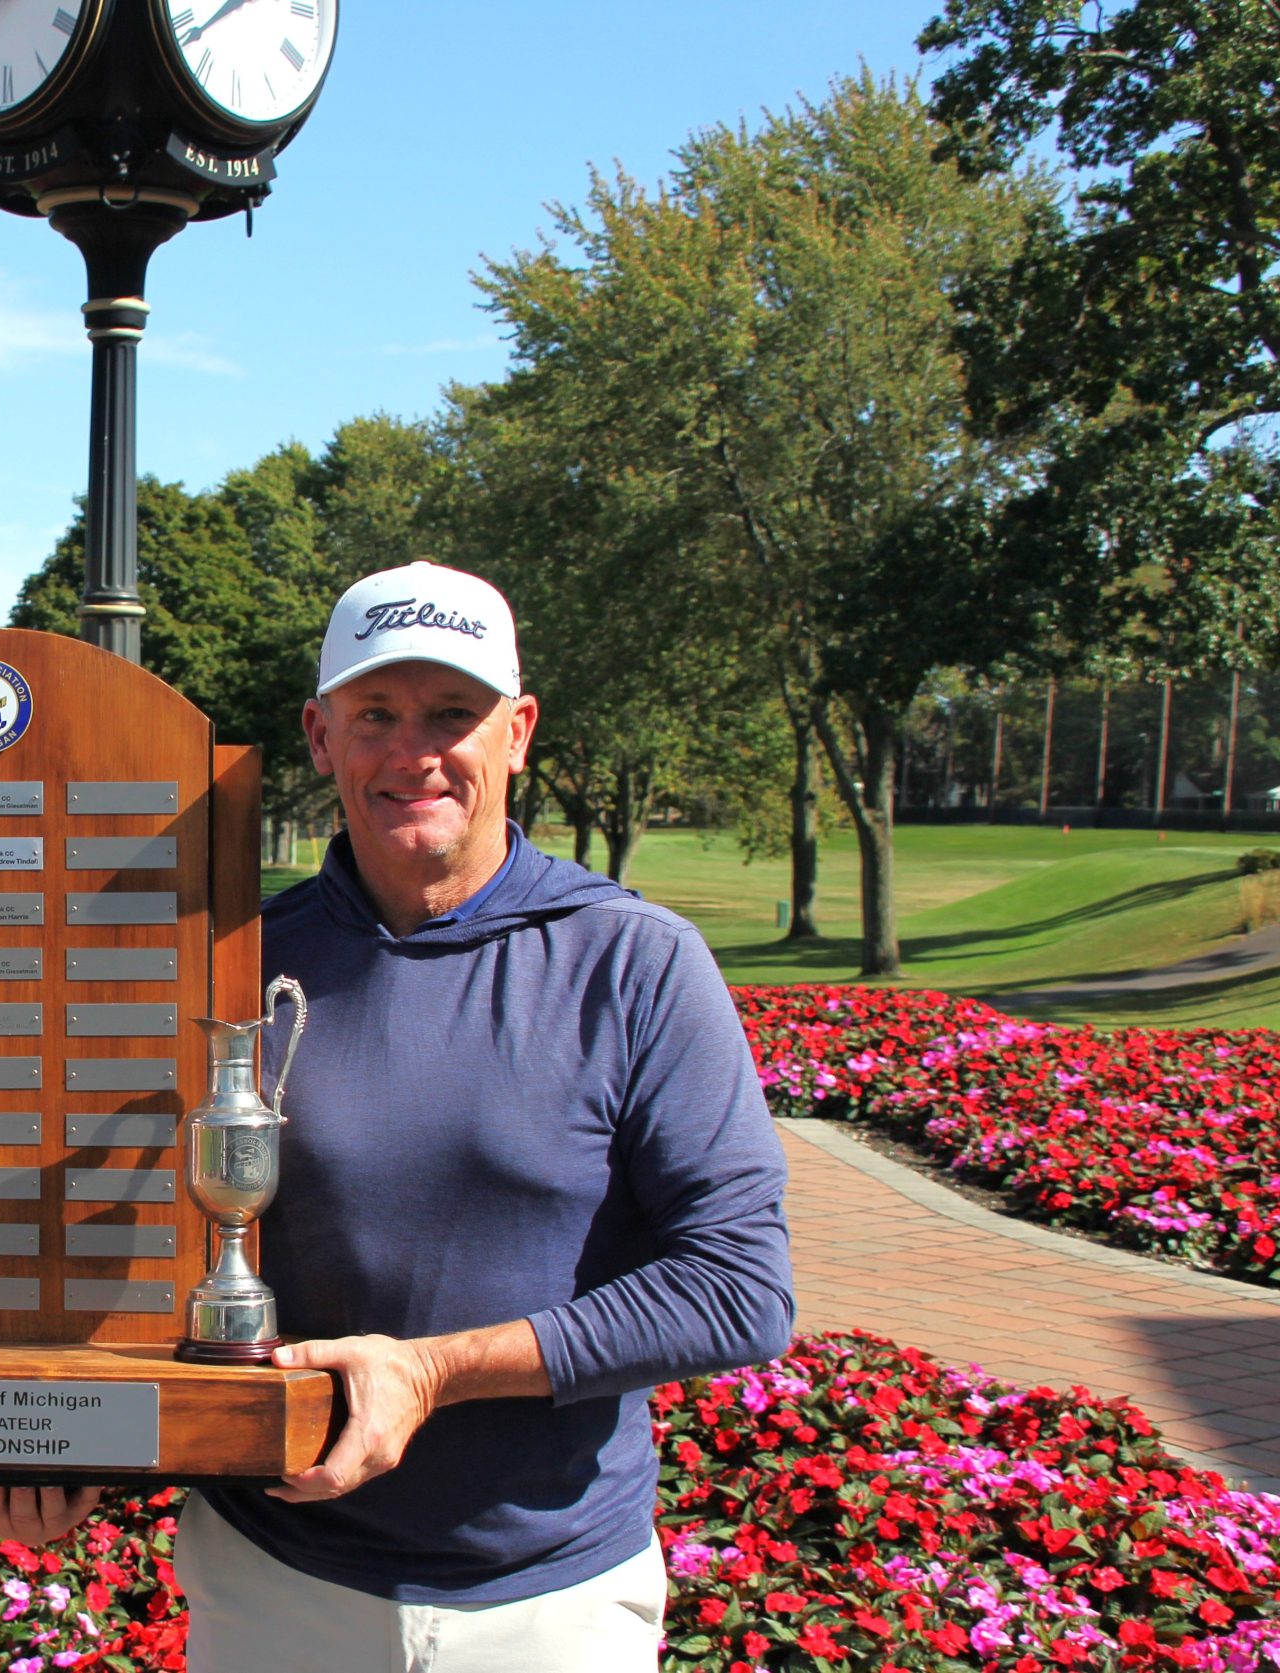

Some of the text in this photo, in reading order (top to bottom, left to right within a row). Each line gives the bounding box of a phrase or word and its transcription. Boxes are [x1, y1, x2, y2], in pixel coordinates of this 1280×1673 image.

[24, 141, 58, 171] 1914
[185, 143, 259, 177] EST. 1914
[355, 598, 487, 640] Titleist
[14, 1391, 102, 1411] Michigan
